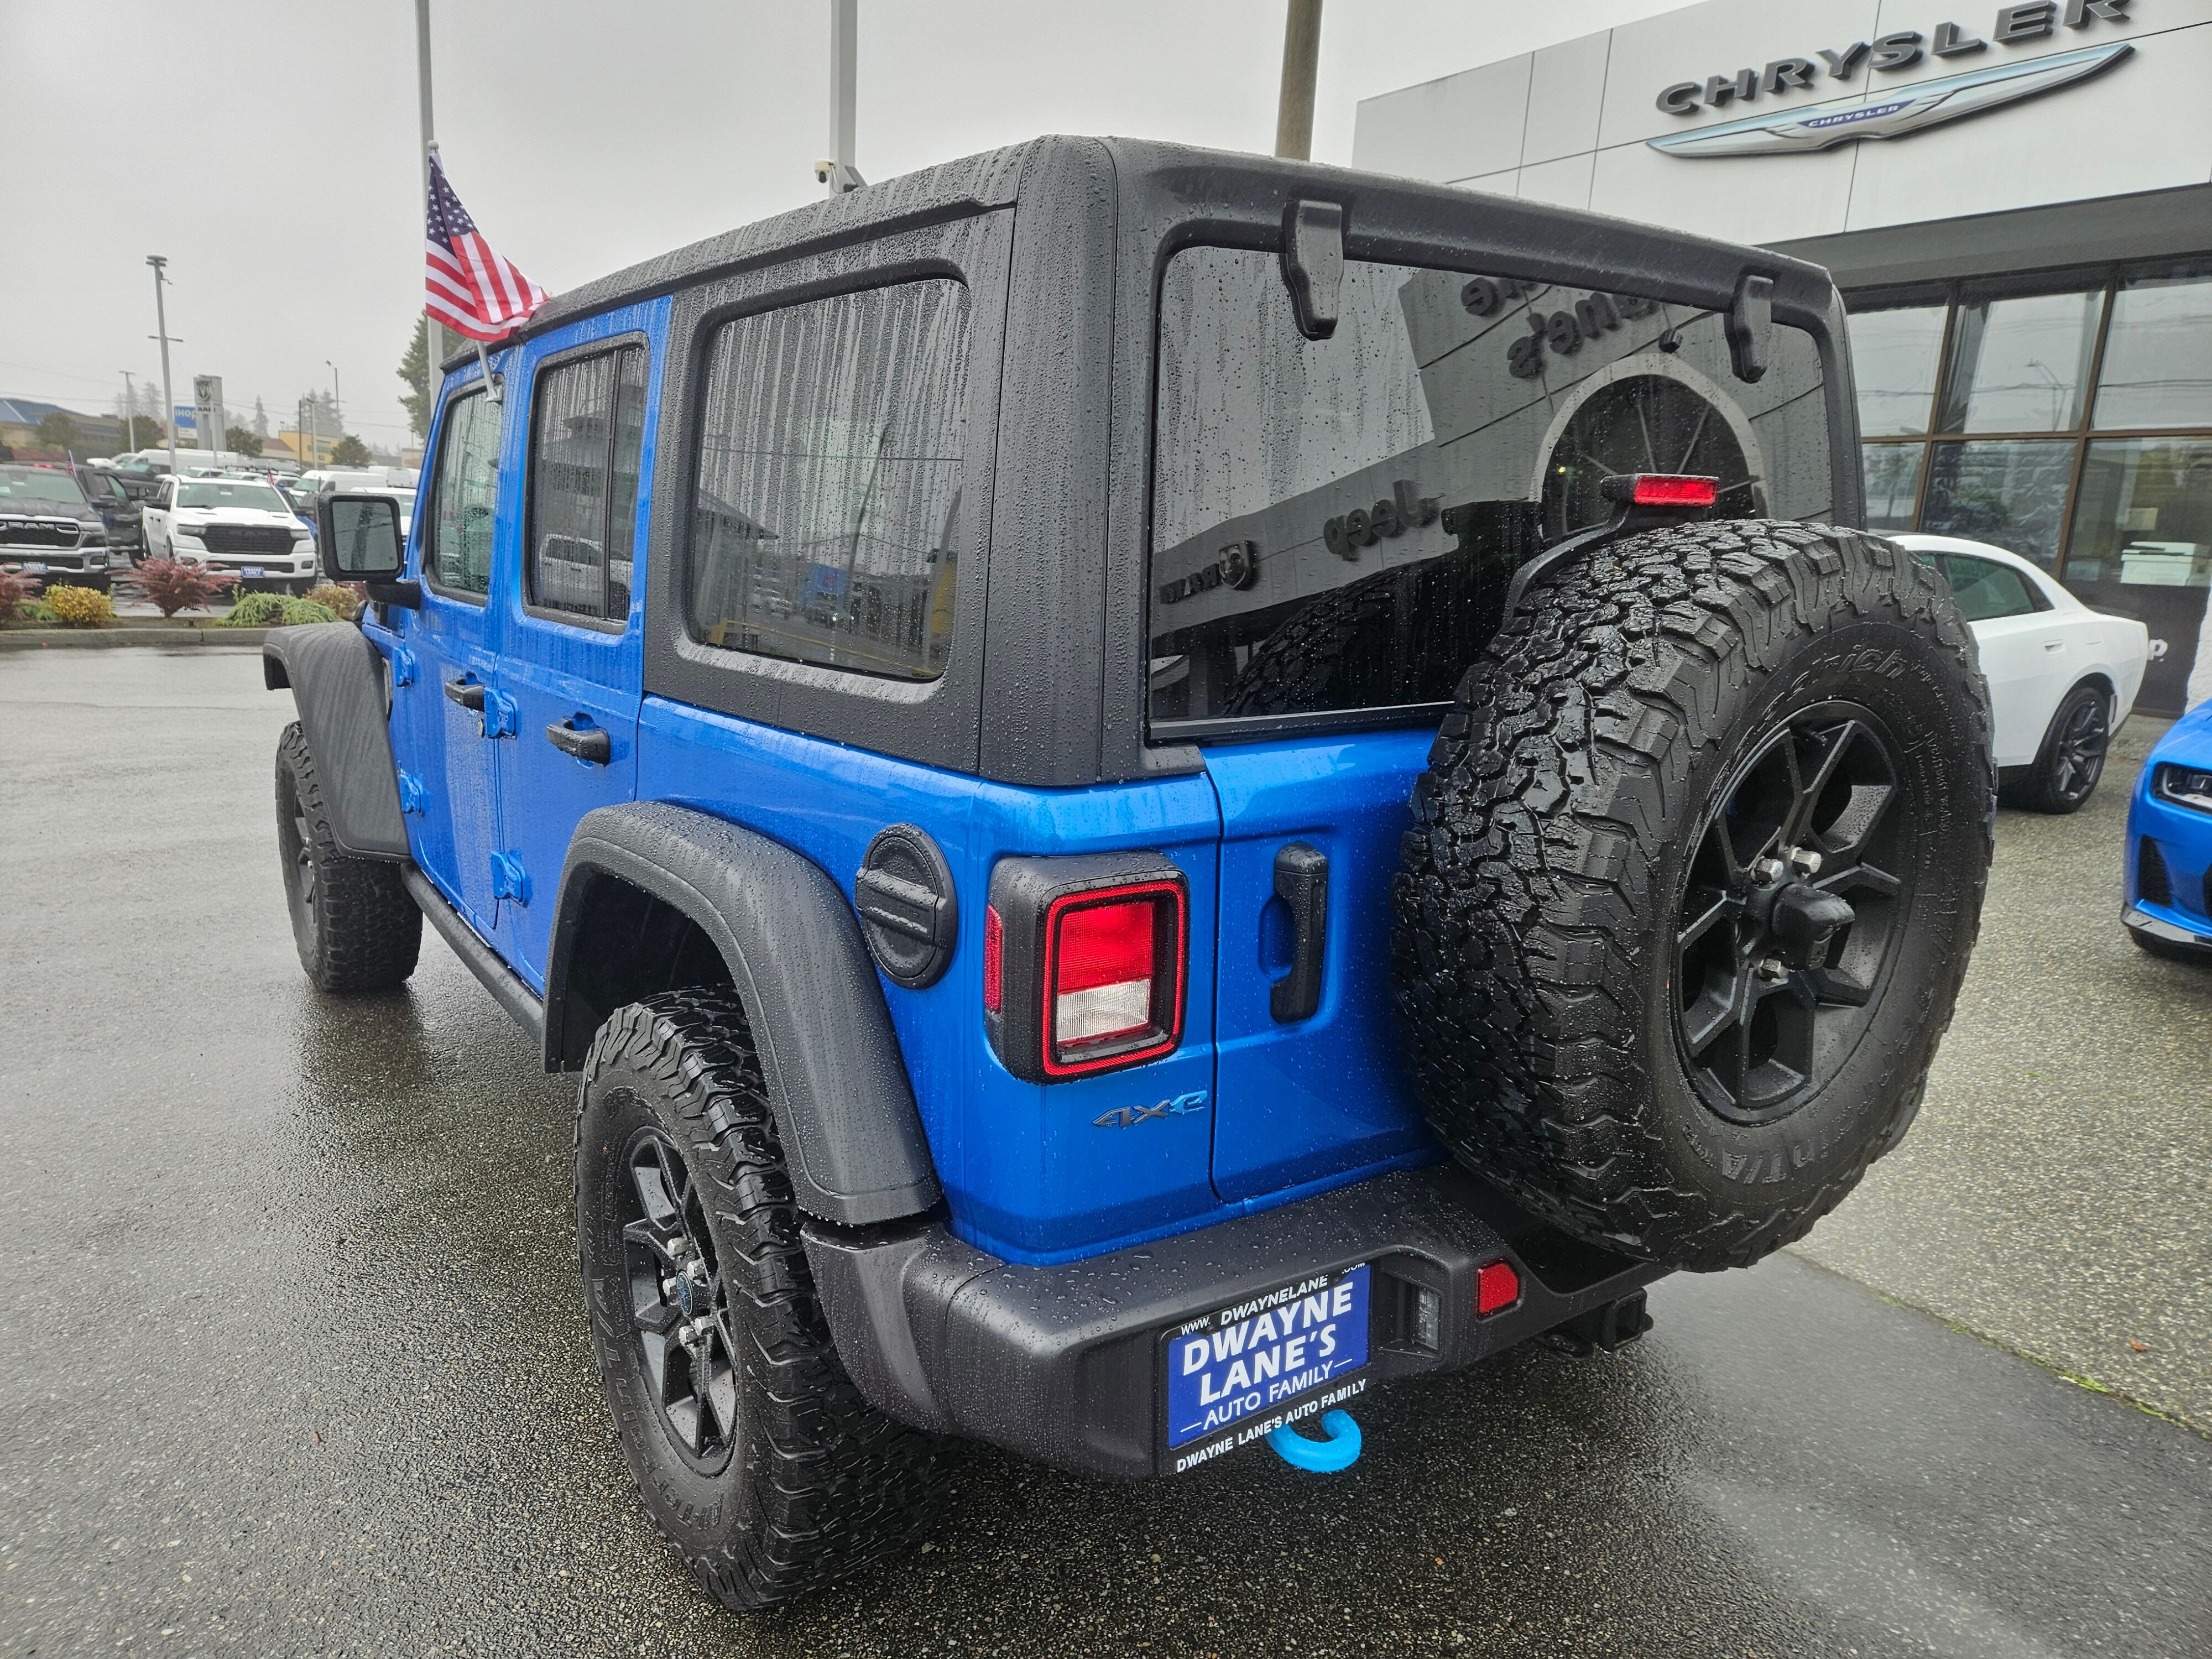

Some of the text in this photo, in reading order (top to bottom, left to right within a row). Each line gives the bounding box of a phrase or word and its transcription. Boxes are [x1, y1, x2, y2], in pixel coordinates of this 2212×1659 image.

[1808, 105, 1898, 128] CHRYSLER
[1183, 1282, 1353, 1376] DWAYNE
[1199, 1324, 1337, 1406] LANE'S
[1177, 1379, 1366, 1473] DWAYNE LANE'S AUTO FAMILY
[1204, 1360, 1333, 1431] AUTO FAMILY
